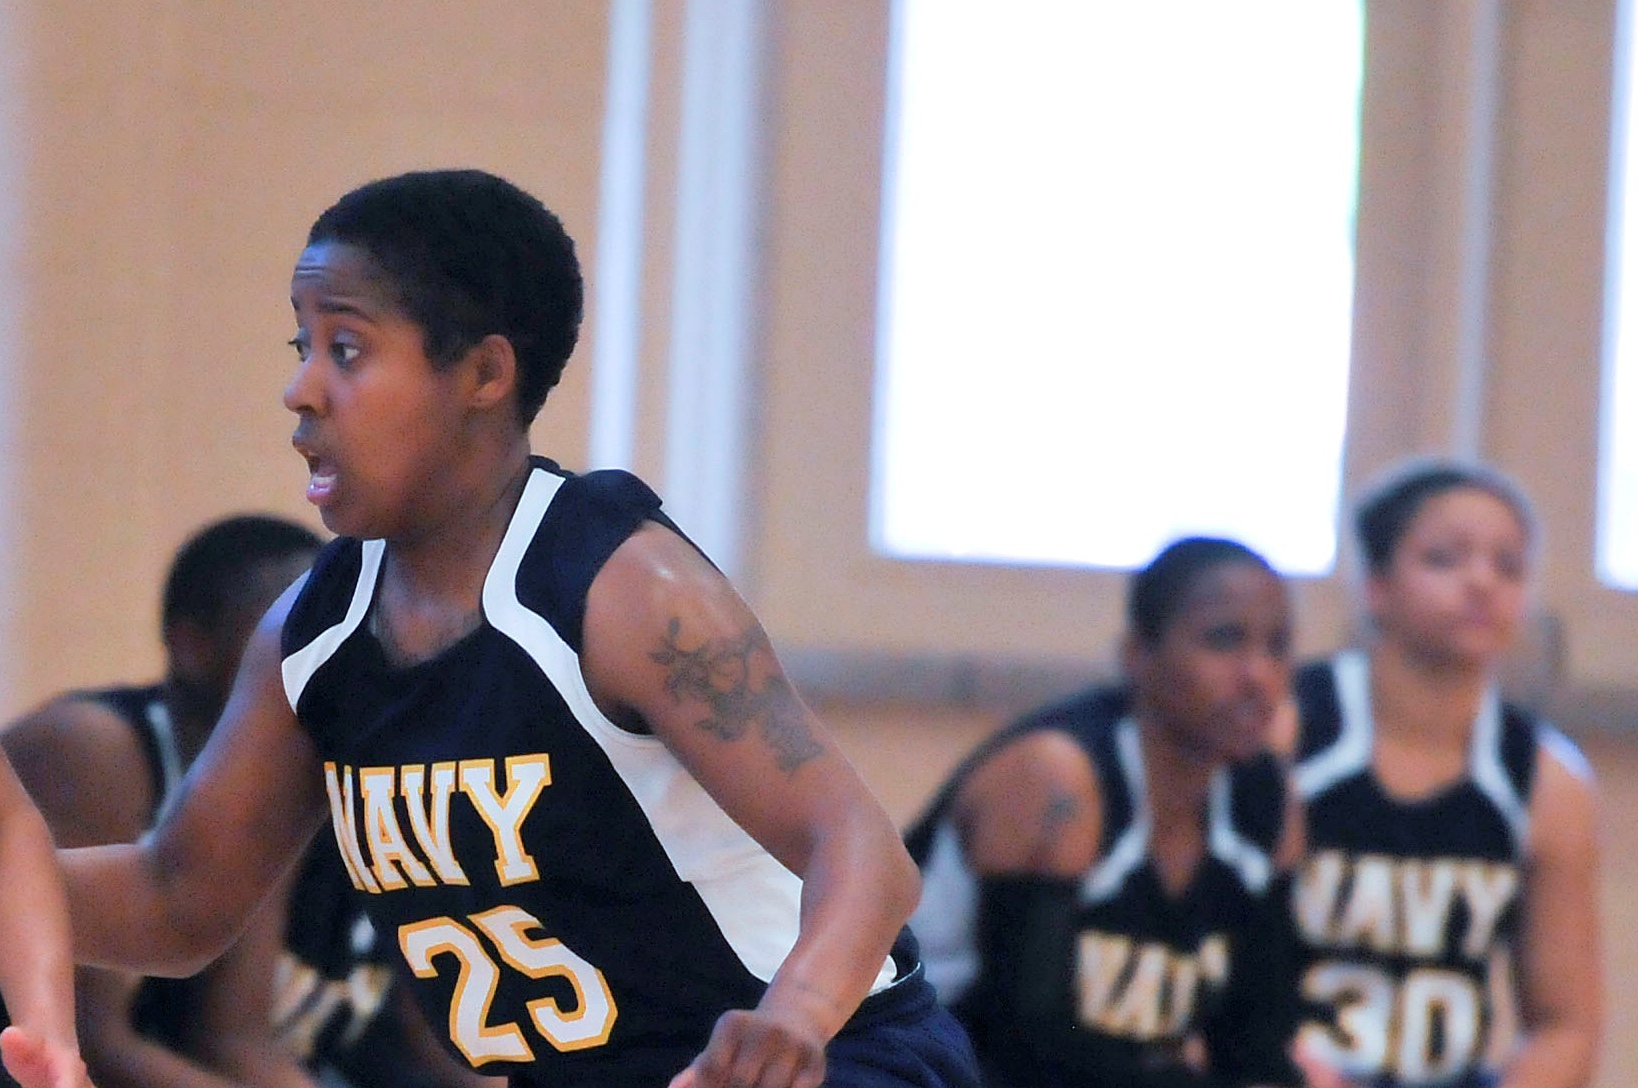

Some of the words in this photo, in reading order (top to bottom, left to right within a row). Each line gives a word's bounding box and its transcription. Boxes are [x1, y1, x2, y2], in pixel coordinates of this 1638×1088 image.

[323, 752, 552, 894] NAVY
[398, 904, 619, 1068] 25
[1292, 961, 1484, 1085] 30
